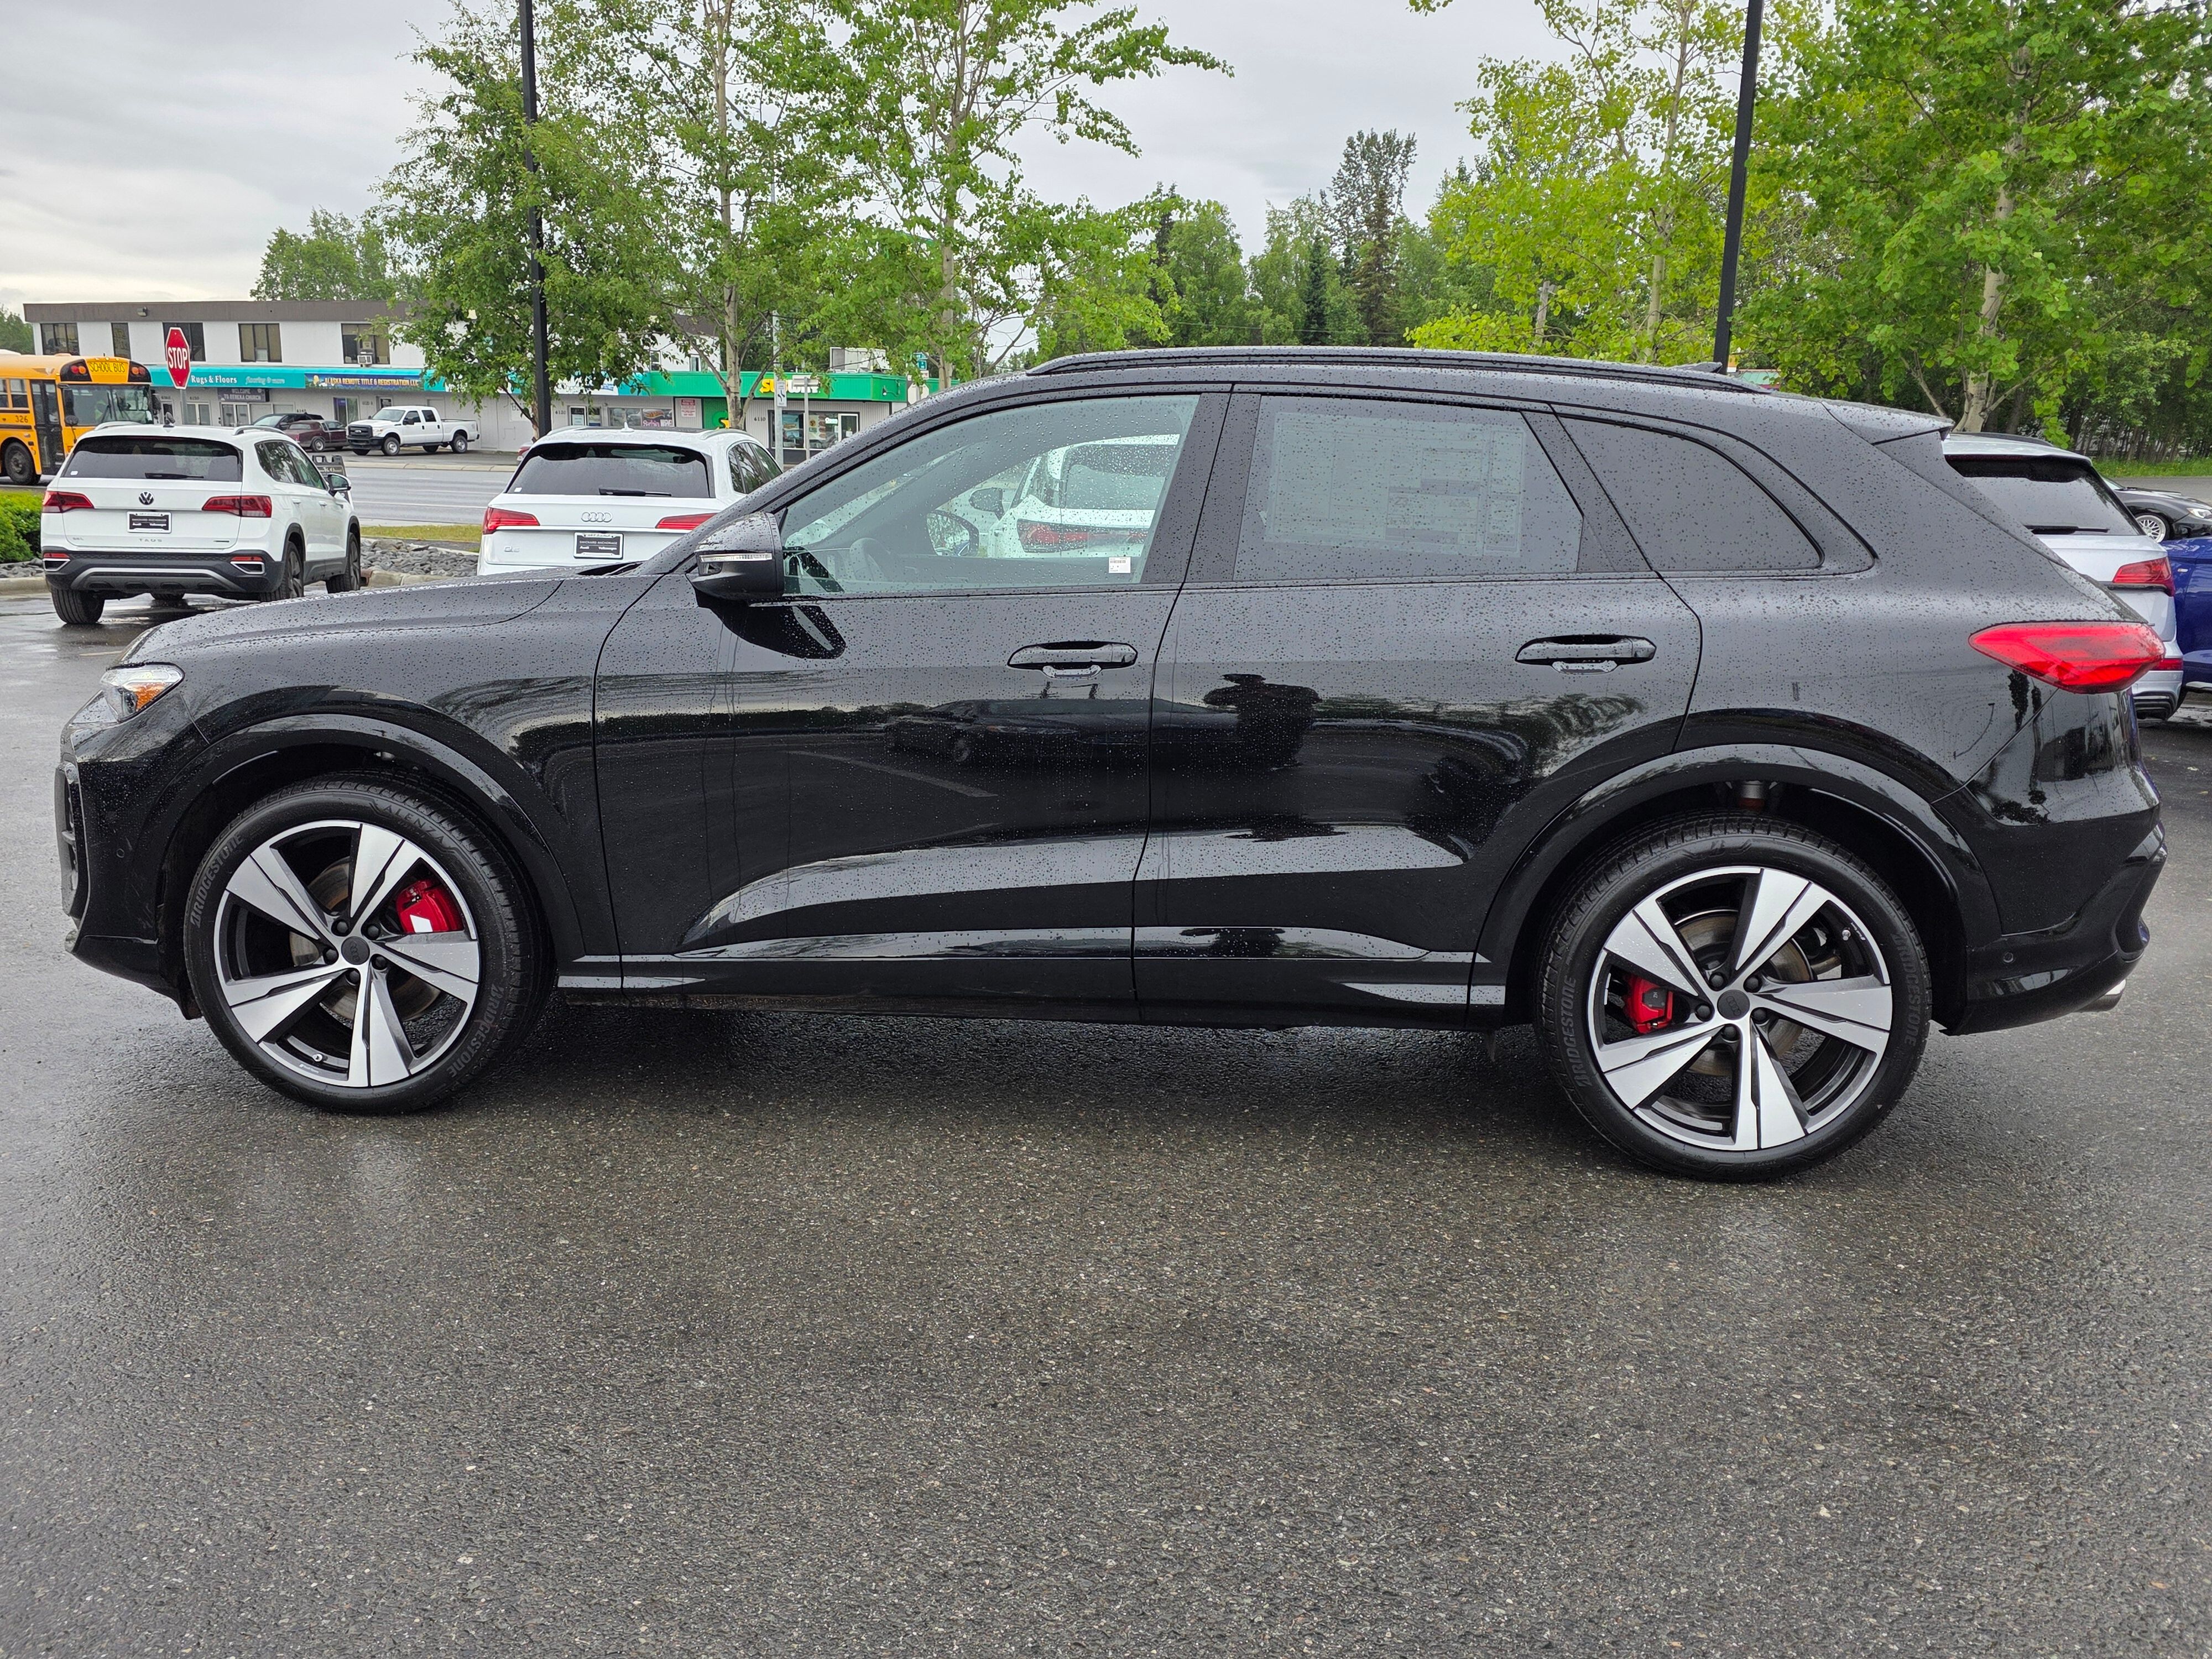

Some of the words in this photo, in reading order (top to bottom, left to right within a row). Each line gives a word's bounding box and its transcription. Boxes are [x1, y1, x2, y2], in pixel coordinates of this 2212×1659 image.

[89, 362, 113, 372] SCHOOL
[113, 362, 126, 373] BUS
[168, 347, 187, 369] STOP
[191, 375, 207, 385] Rugs
[215, 375, 237, 383] Floors
[383, 804, 445, 844] ALENZA
[190, 833, 243, 929] BRIDGESTONE
[1890, 933, 1921, 1046] BRIDGESTONE
[446, 983, 505, 1078] BRIDGESTONE
[1561, 974, 1593, 1087] BRIDGESTONE
